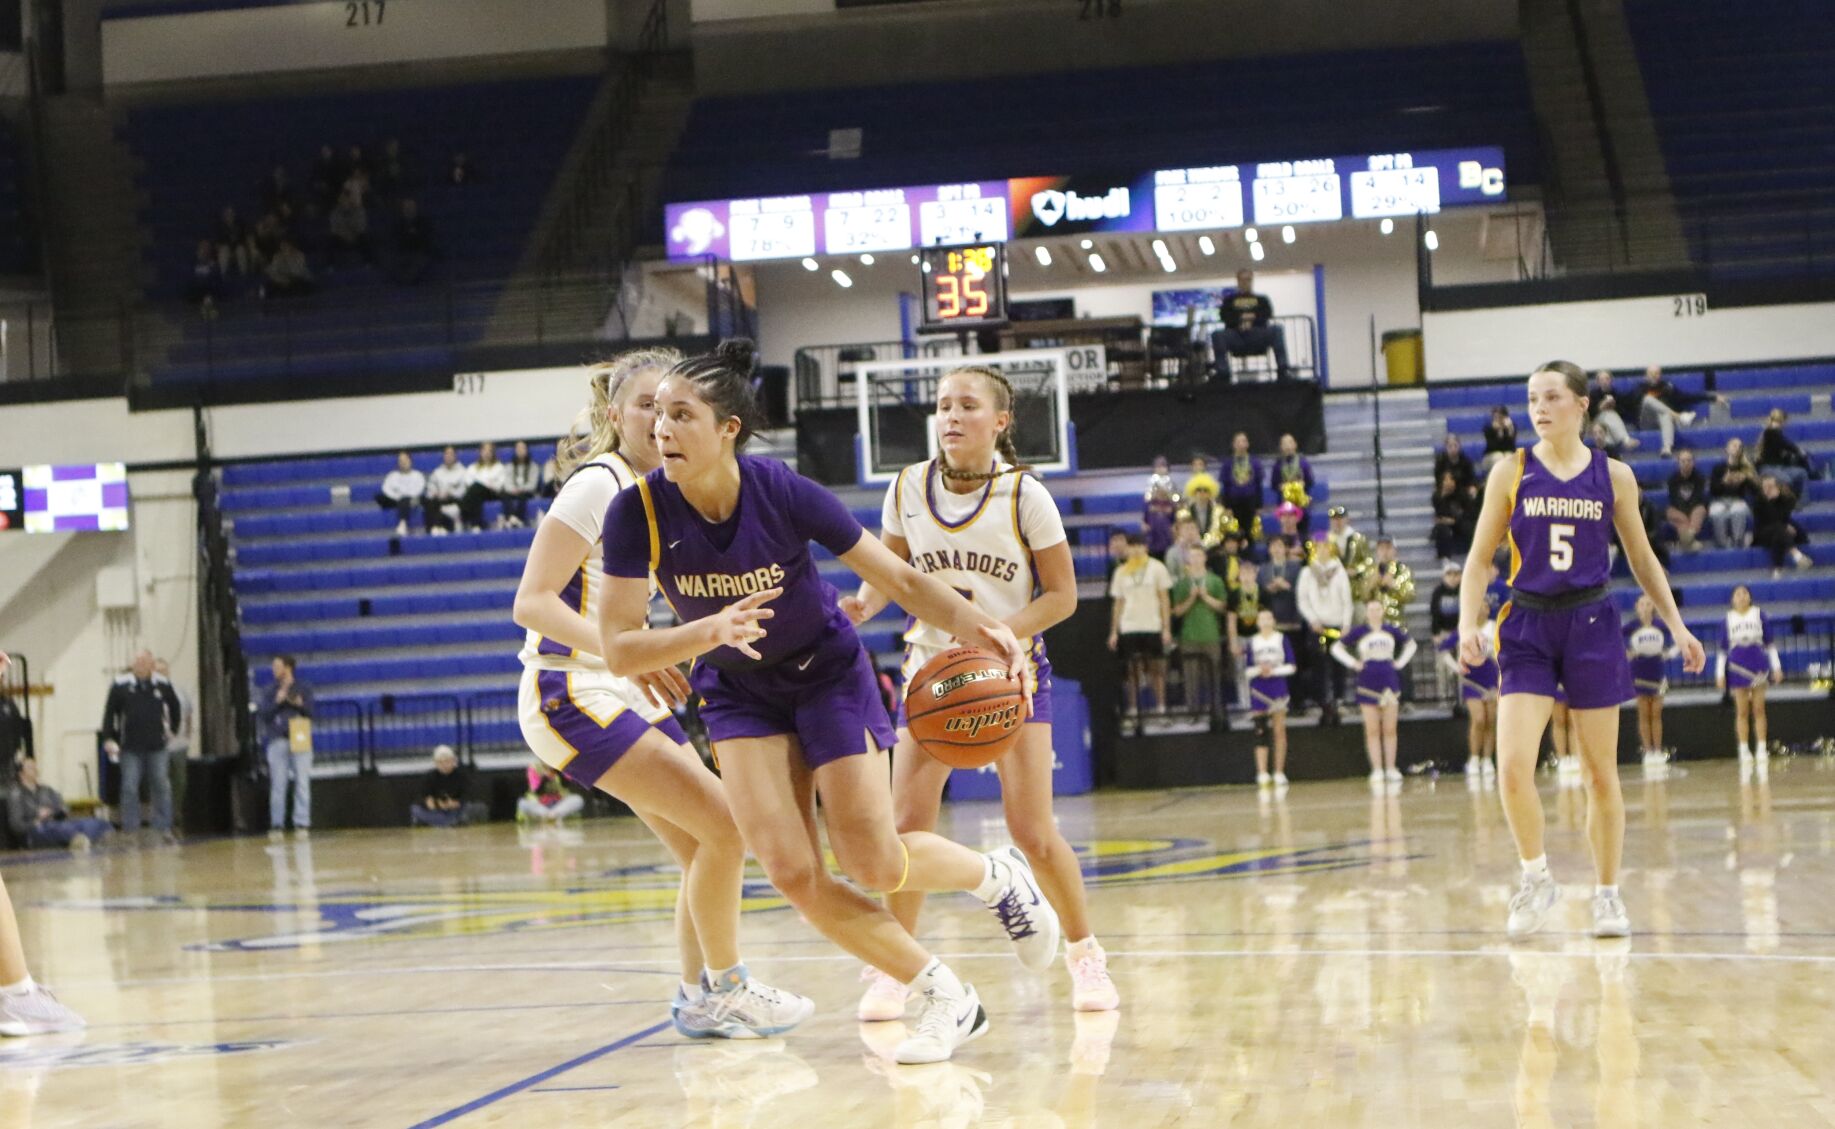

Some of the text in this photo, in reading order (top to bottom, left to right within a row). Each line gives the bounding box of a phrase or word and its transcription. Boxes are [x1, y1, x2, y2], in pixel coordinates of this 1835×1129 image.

[346, 1, 386, 26] 217
[1262, 178, 1334, 195] 13 26
[1404, 173, 1425, 186] 14
[1458, 160, 1505, 195] BC
[874, 208, 898, 222] 22
[971, 203, 994, 217] 14
[1065, 187, 1130, 221] hudl
[936, 275, 988, 318] 35
[1673, 296, 1706, 317] 219
[457, 374, 486, 395] 217
[1523, 496, 1604, 521] WARRIORS
[1549, 523, 1576, 571] 5
[915, 549, 1019, 582] RNADOES
[674, 562, 785, 598] WARRIORS
[944, 703, 1020, 738] Baden
